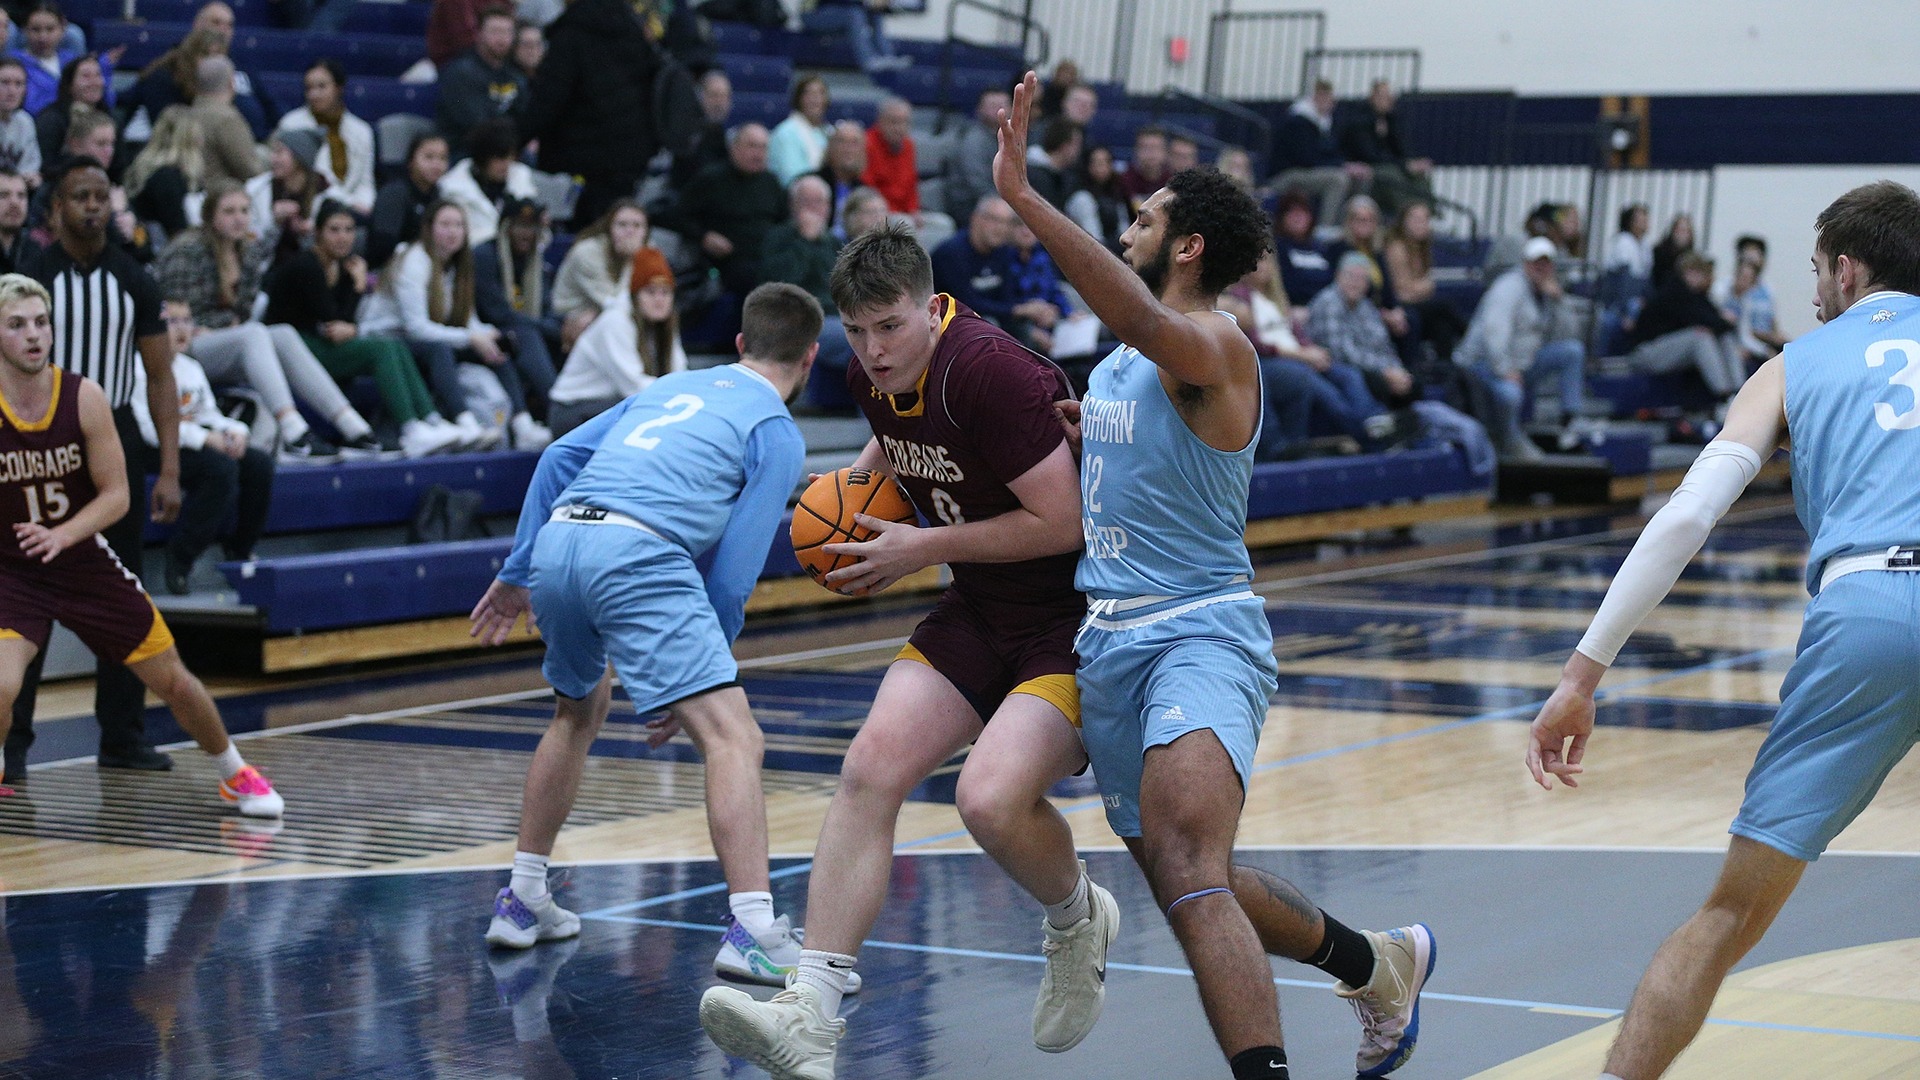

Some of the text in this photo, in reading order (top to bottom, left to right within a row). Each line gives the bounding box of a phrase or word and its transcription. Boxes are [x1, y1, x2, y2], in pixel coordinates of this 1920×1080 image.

[1864, 338, 1920, 431] 3
[623, 393, 705, 451] 2
[0, 442, 82, 483] COUGARS
[882, 434, 964, 483] COUGARS
[1085, 453, 1103, 513] 12
[22, 481, 70, 523] 15
[930, 487, 965, 525] 0
